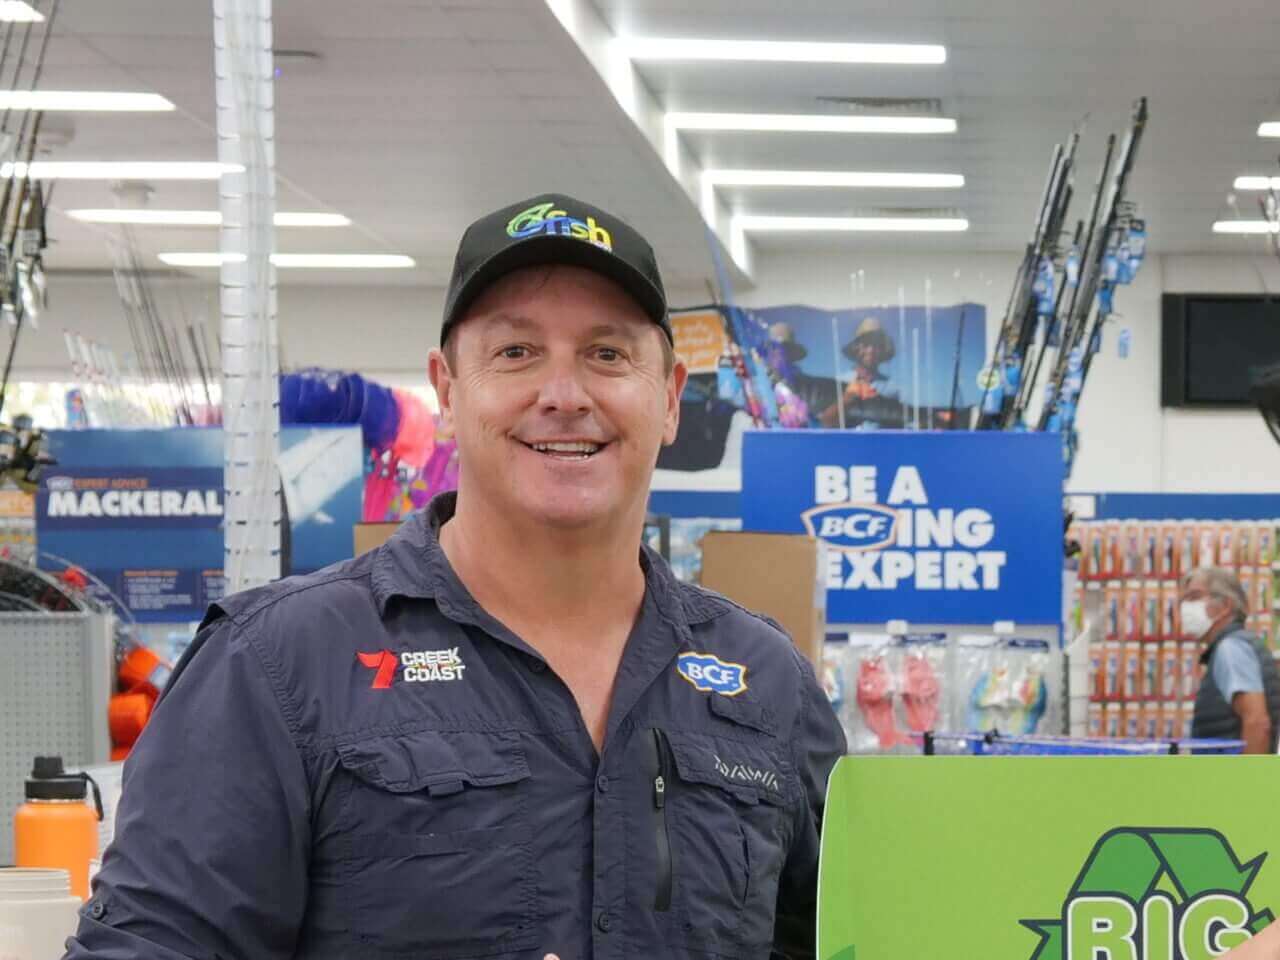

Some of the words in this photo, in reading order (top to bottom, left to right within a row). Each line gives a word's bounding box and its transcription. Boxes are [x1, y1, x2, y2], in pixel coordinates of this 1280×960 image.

[815, 465, 878, 504] BE
[887, 465, 928, 504] A
[48, 490, 224, 517] MACKERAL
[827, 551, 1006, 590] EXPERT
[401, 646, 462, 665] CREEK
[404, 664, 465, 682] COAST
[686, 662, 734, 685] BCF
